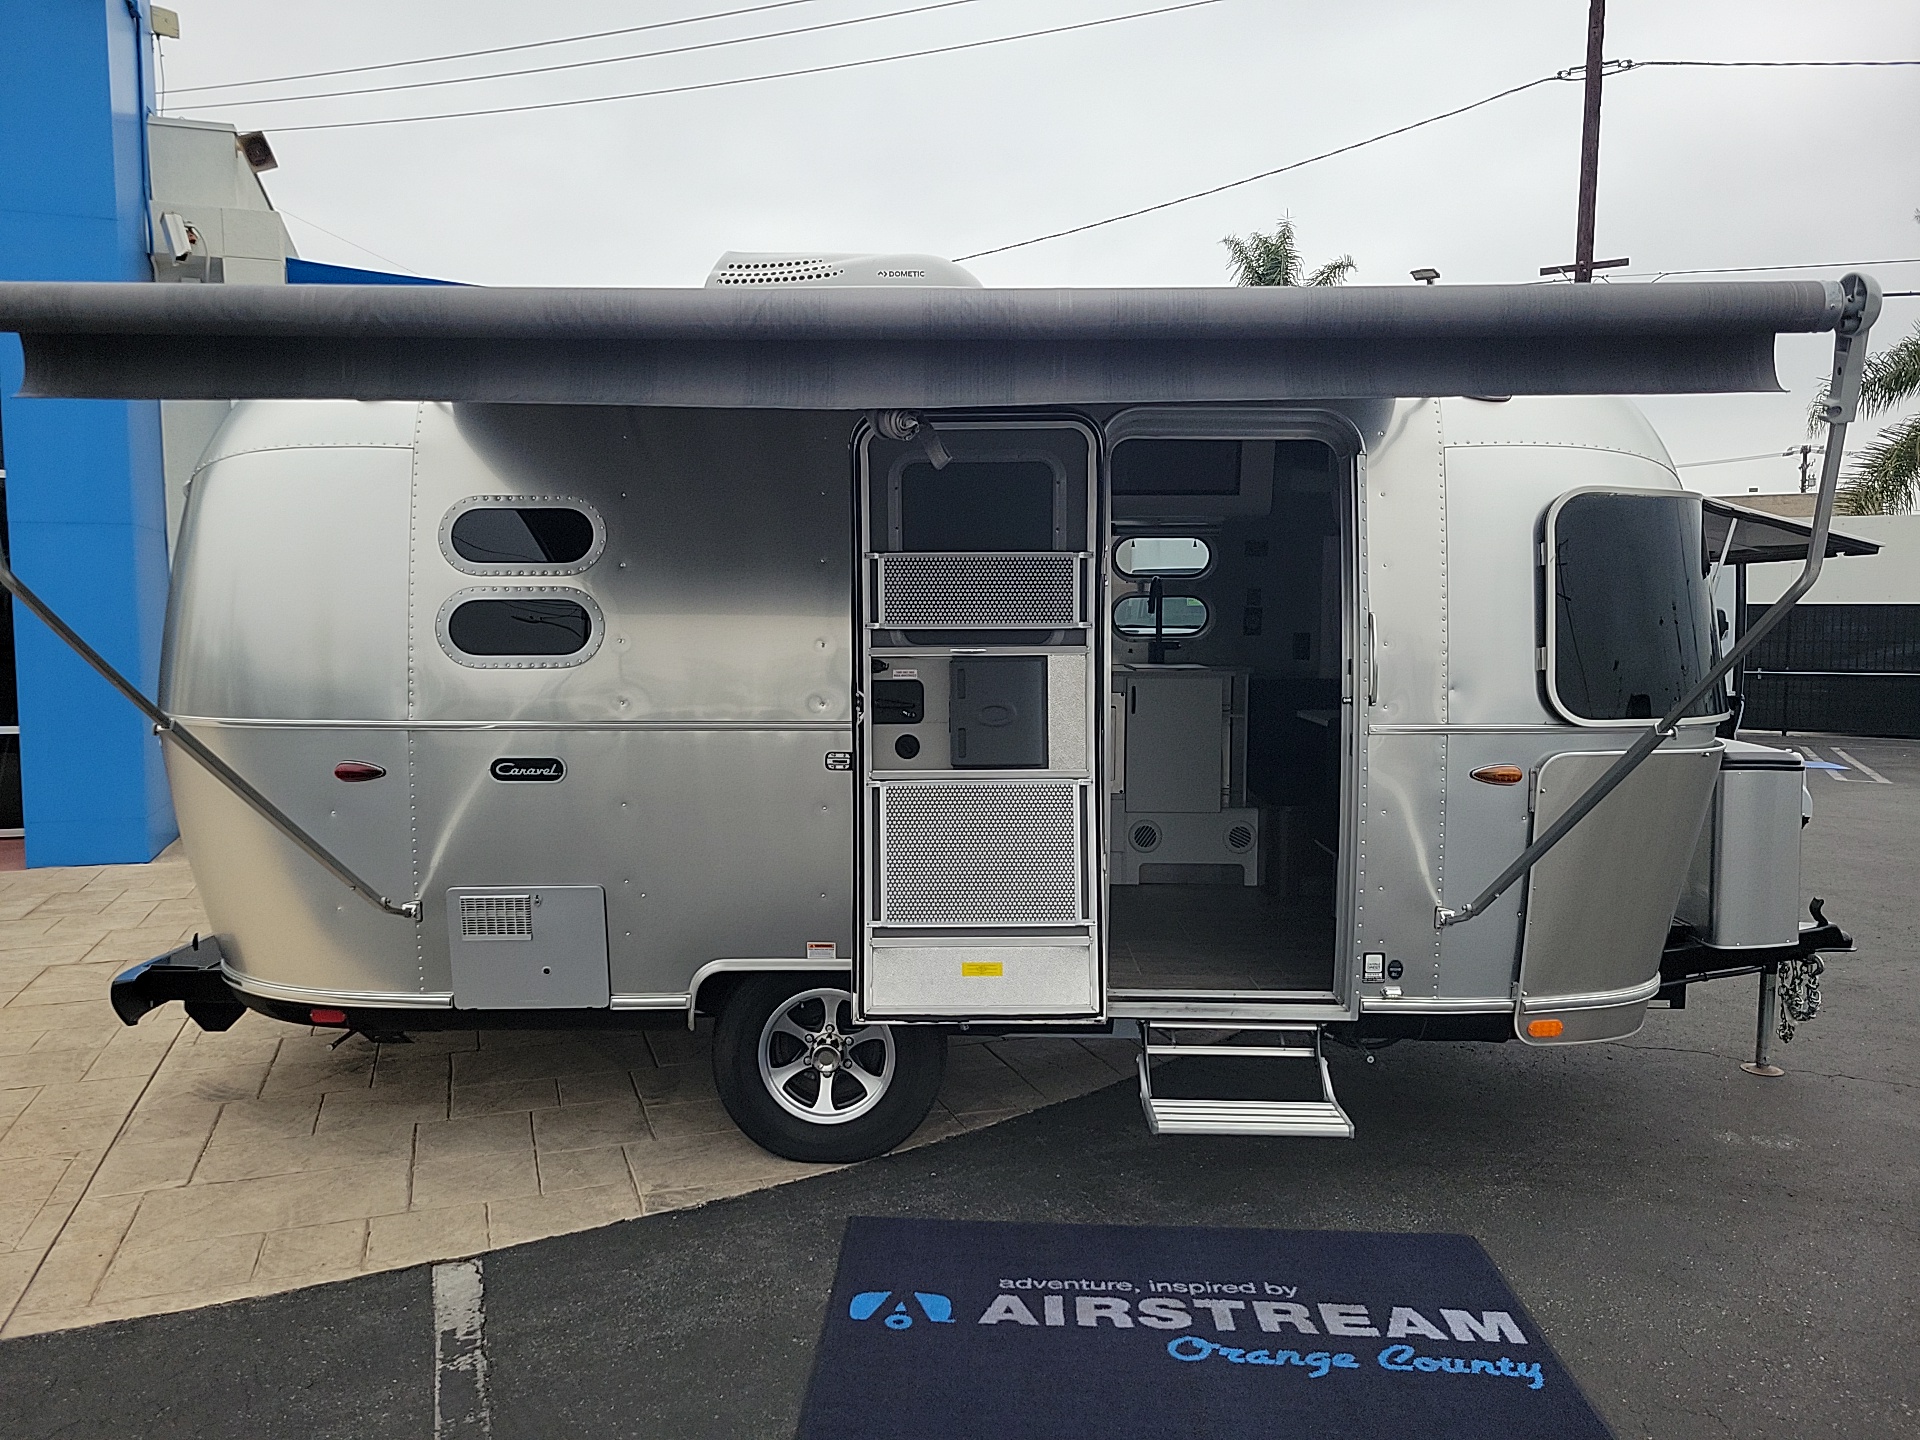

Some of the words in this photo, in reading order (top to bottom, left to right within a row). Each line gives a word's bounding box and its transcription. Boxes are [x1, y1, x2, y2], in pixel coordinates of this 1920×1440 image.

[888, 270, 925, 278] DOMETIC
[495, 762, 559, 776] Caravel
[1000, 1277, 1141, 1293] adventure,
[1148, 1279, 1257, 1295] inspired
[1264, 1282, 1297, 1298] by
[978, 1294, 1529, 1344] AIRSTREAM
[1167, 1335, 1360, 1378] Orange
[1377, 1344, 1544, 1390] County
